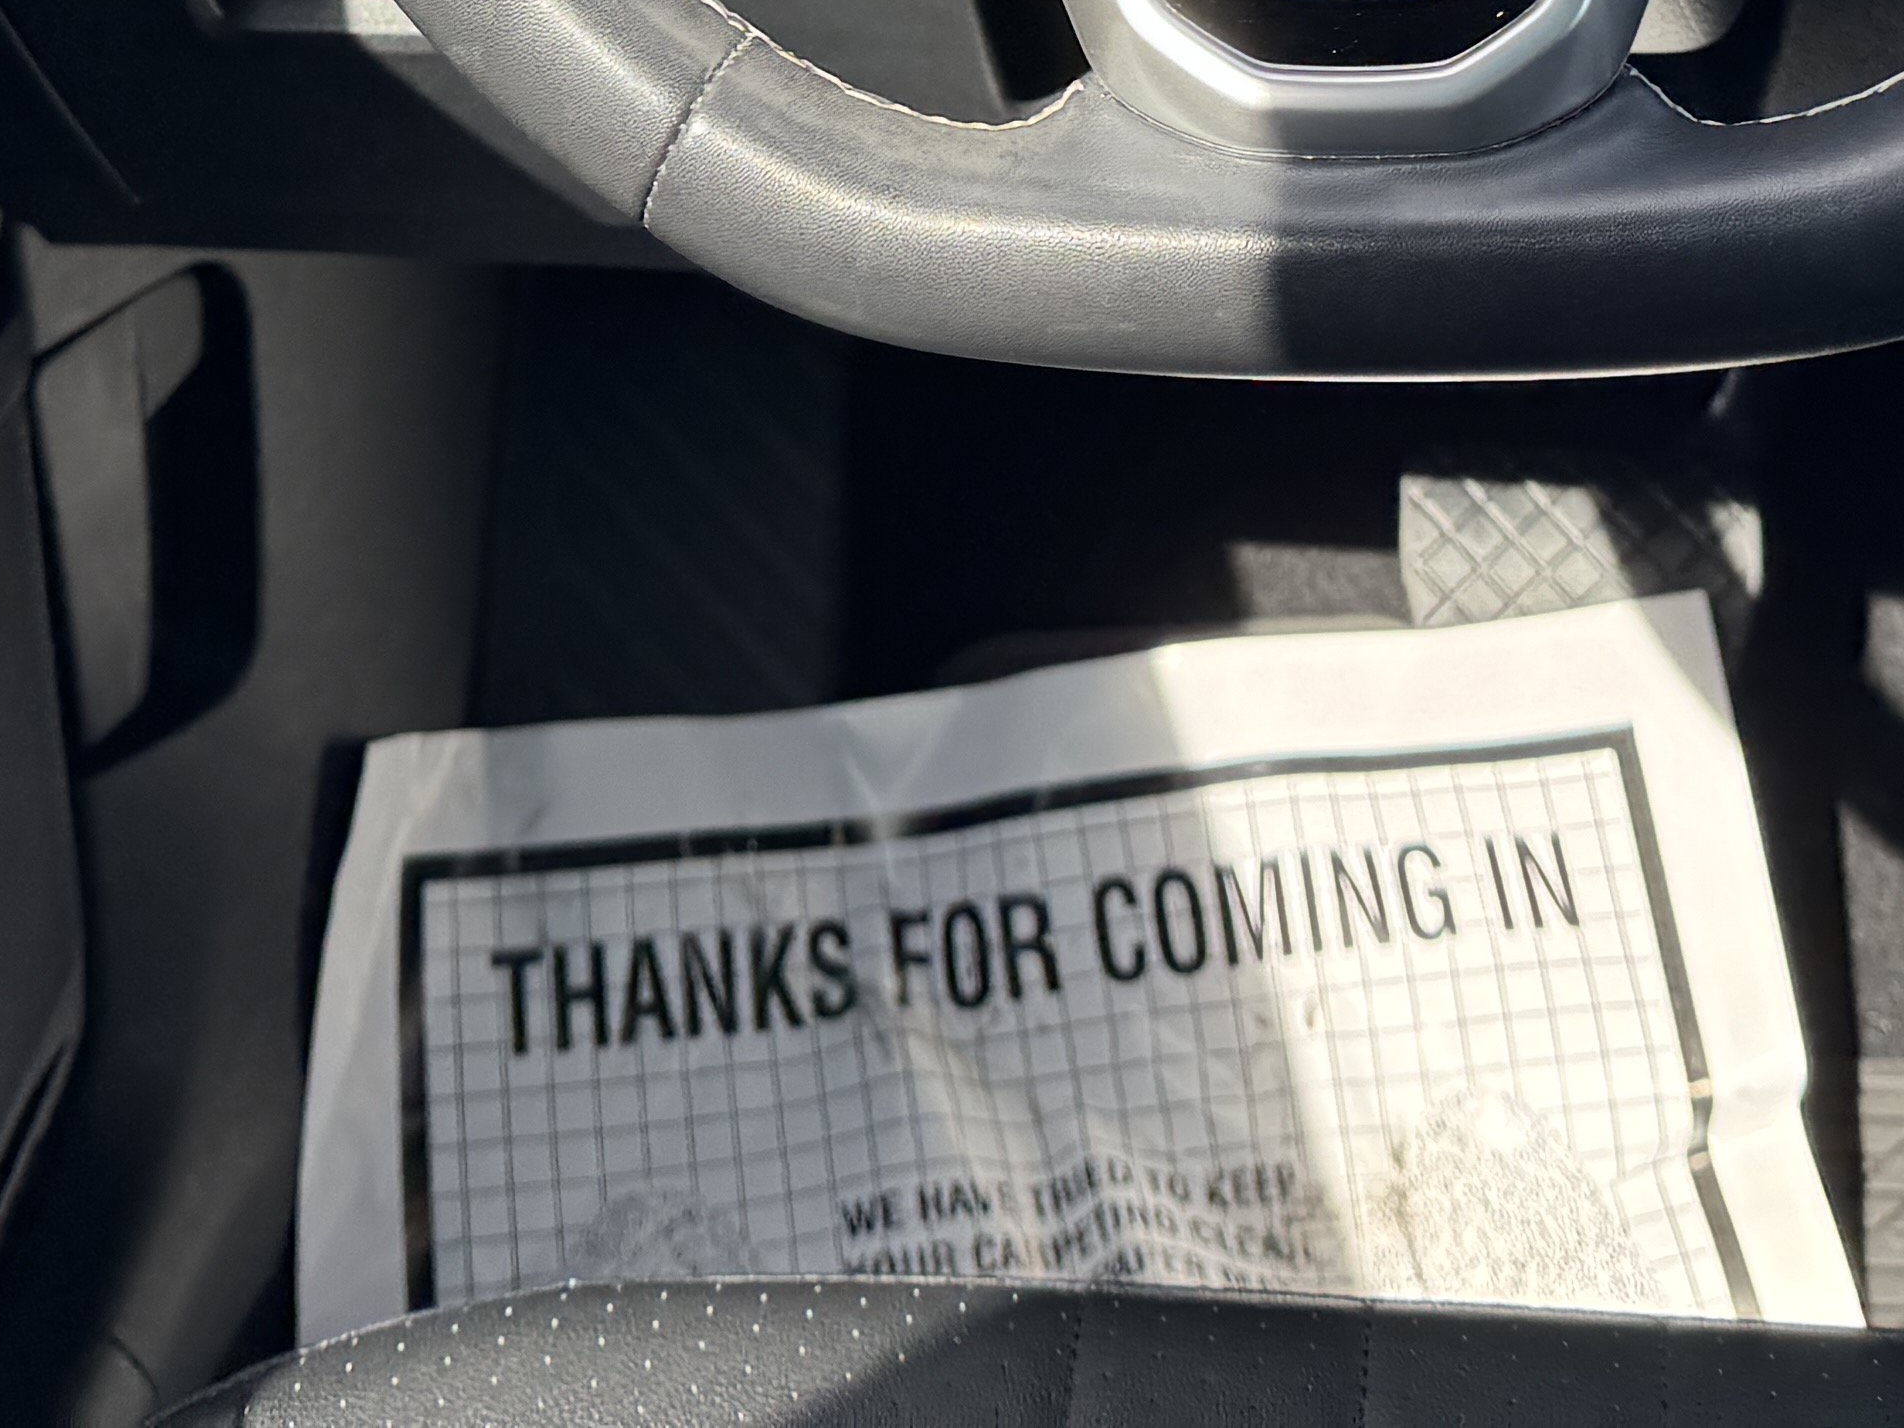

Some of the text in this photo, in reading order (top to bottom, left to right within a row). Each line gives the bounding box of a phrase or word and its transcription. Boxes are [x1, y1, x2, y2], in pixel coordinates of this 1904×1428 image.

[490, 831, 1581, 1056] THANKS FOR COMING IN
[840, 1186, 904, 1237] WE
[1146, 1165, 1190, 1204] TO
[1206, 1160, 1296, 1210] KEEP
